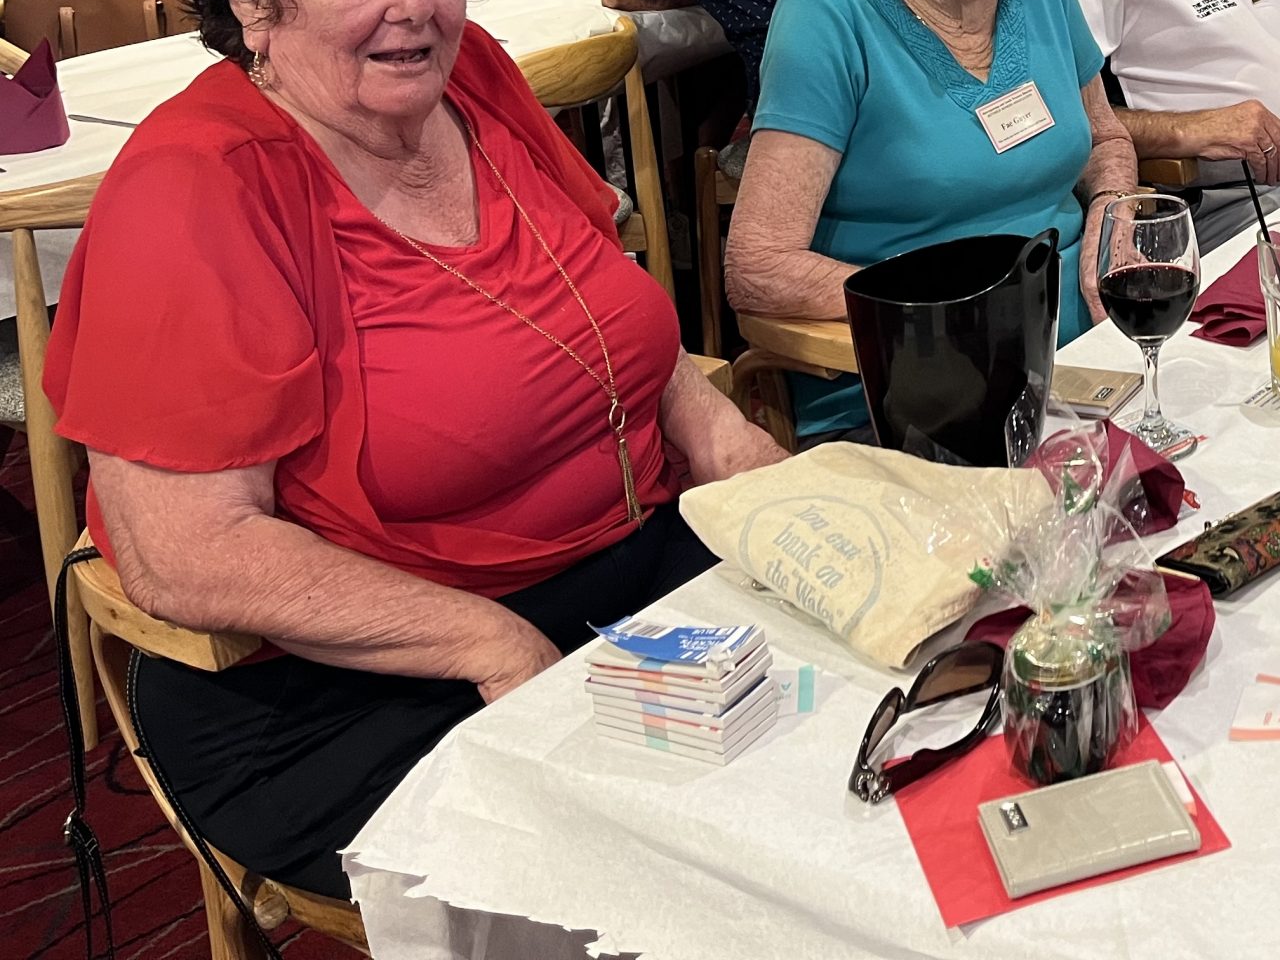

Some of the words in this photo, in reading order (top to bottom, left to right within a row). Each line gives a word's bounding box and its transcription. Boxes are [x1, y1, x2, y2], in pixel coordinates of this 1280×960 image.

[772, 521, 823, 572] bank
[816, 565, 844, 589] on
[794, 503, 830, 531] You
[825, 533, 860, 560] can
[765, 558, 789, 593] the
